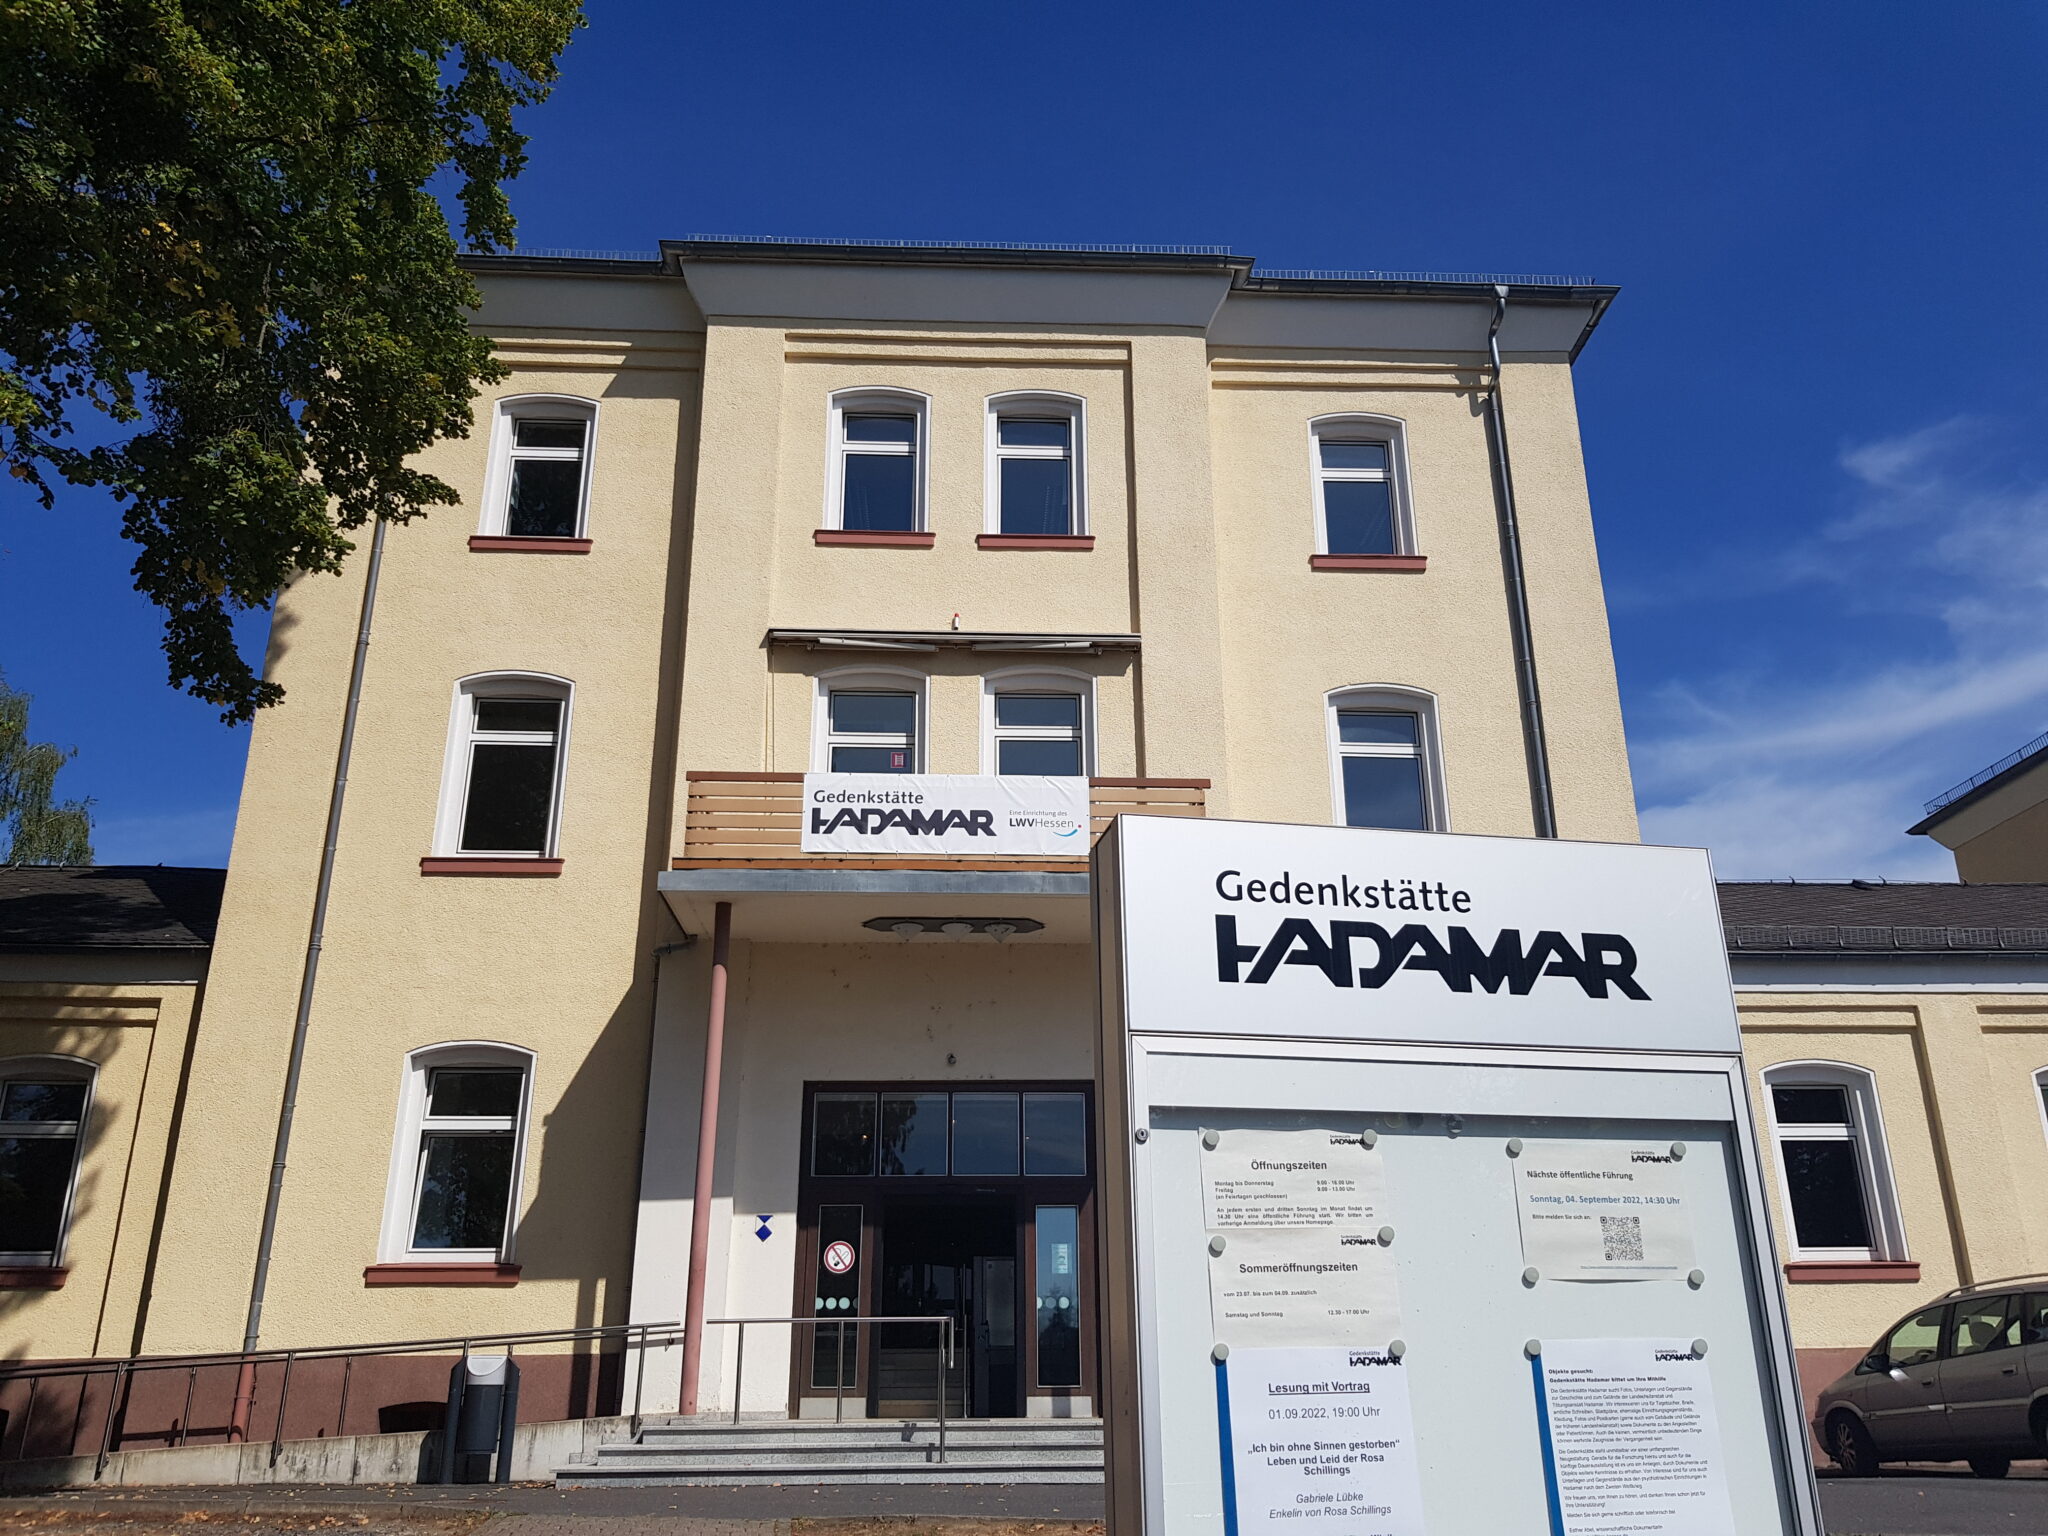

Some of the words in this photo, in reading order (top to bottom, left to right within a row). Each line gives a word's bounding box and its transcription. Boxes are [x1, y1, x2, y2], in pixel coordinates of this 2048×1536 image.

[814, 789, 924, 804] Gedenkstätte
[811, 807, 997, 837] HADAMAR
[1009, 818, 1074, 828] LWVHessen
[1216, 870, 1471, 914] Gedenkstätte
[1215, 914, 1653, 1001] HADAMAR
[1631, 1155, 1672, 1163] HADAMAR
[1251, 1159, 1327, 1172] Öffnungszeiten
[1527, 1170, 1558, 1179] Nächste
[1559, 1171, 1601, 1179] öffentliche
[1602, 1171, 1634, 1181] Führung
[1530, 1195, 1564, 1205] Sonntag,
[1565, 1195, 1578, 1203] 04.
[1579, 1195, 1621, 1205] September
[1622, 1196, 1643, 1205] 2022,
[1644, 1196, 1665, 1204] 14:30
[1666, 1197, 1680, 1205] Uhr
[1296, 1206, 1318, 1214] Sonntag
[1239, 1262, 1358, 1274] Sommeröffnungszeiten
[1349, 1356, 1402, 1367] HADAMAR
[1268, 1383, 1310, 1394] Lesung
[1313, 1382, 1329, 1392] mit
[1332, 1381, 1370, 1393] Vortrag
[1268, 1407, 1330, 1420] 01.09.2022,
[1332, 1407, 1360, 1418] 19:00
[1362, 1406, 1381, 1417] Uhr
[1270, 1443, 1285, 1453] bin
[1288, 1442, 1311, 1452] ohne
[1314, 1441, 1346, 1451] Sinnen
[1267, 1456, 1297, 1466] Leben
[1299, 1455, 1317, 1465] und
[1320, 1454, 1340, 1464] Leid
[1343, 1454, 1358, 1463] der
[1360, 1453, 1384, 1462] Rosa
[1304, 1465, 1351, 1477] Schillings
[1296, 1493, 1334, 1504] Gabriele
[1336, 1492, 1364, 1502] Lübke
[1269, 1508, 1303, 1519] Enkelin
[1305, 1509, 1322, 1517] von
[1324, 1506, 1348, 1516] Rosa
[1350, 1505, 1392, 1517] Schillings
